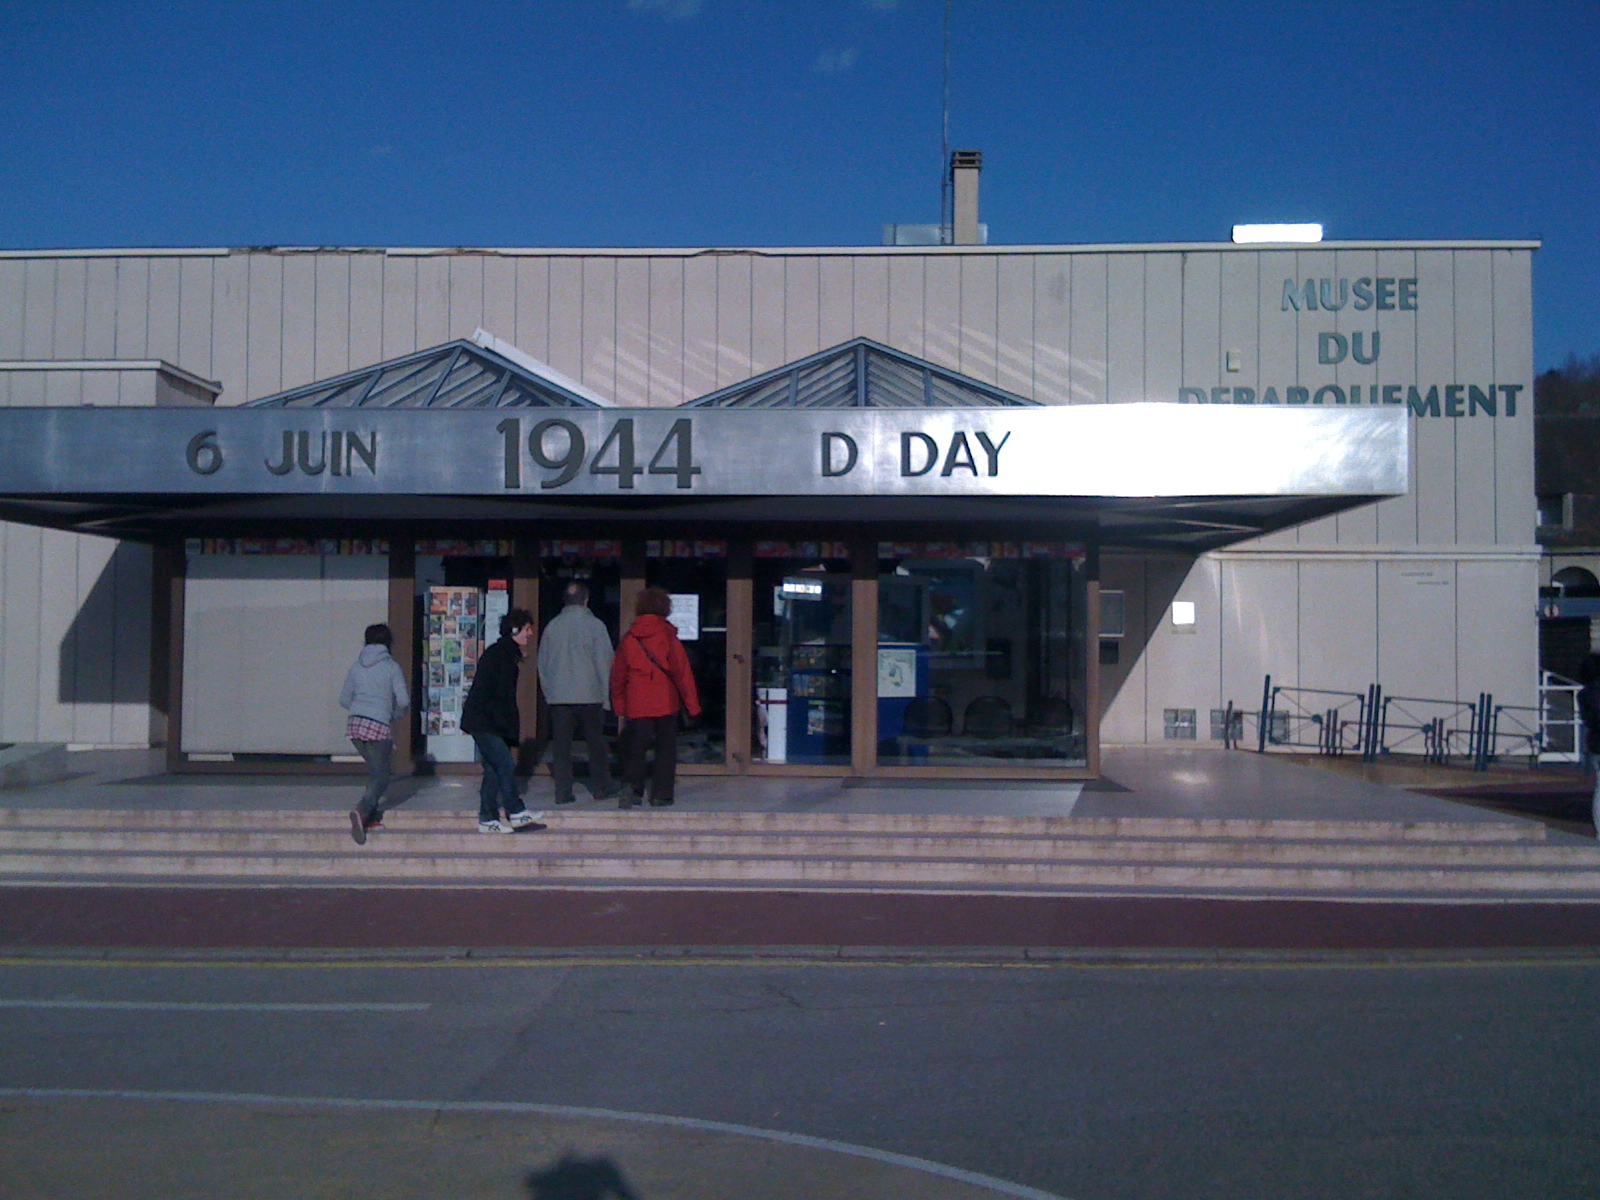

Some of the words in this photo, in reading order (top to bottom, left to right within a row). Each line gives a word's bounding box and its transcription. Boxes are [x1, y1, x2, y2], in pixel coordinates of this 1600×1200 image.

[1281, 277, 1418, 311] MUSEE
[1318, 331, 1380, 365] DU
[185, 430, 225, 477] 6
[264, 430, 377, 477] JUIN
[496, 417, 701, 490] 1944
[821, 432, 859, 477] D
[900, 431, 1012, 477] DAY
